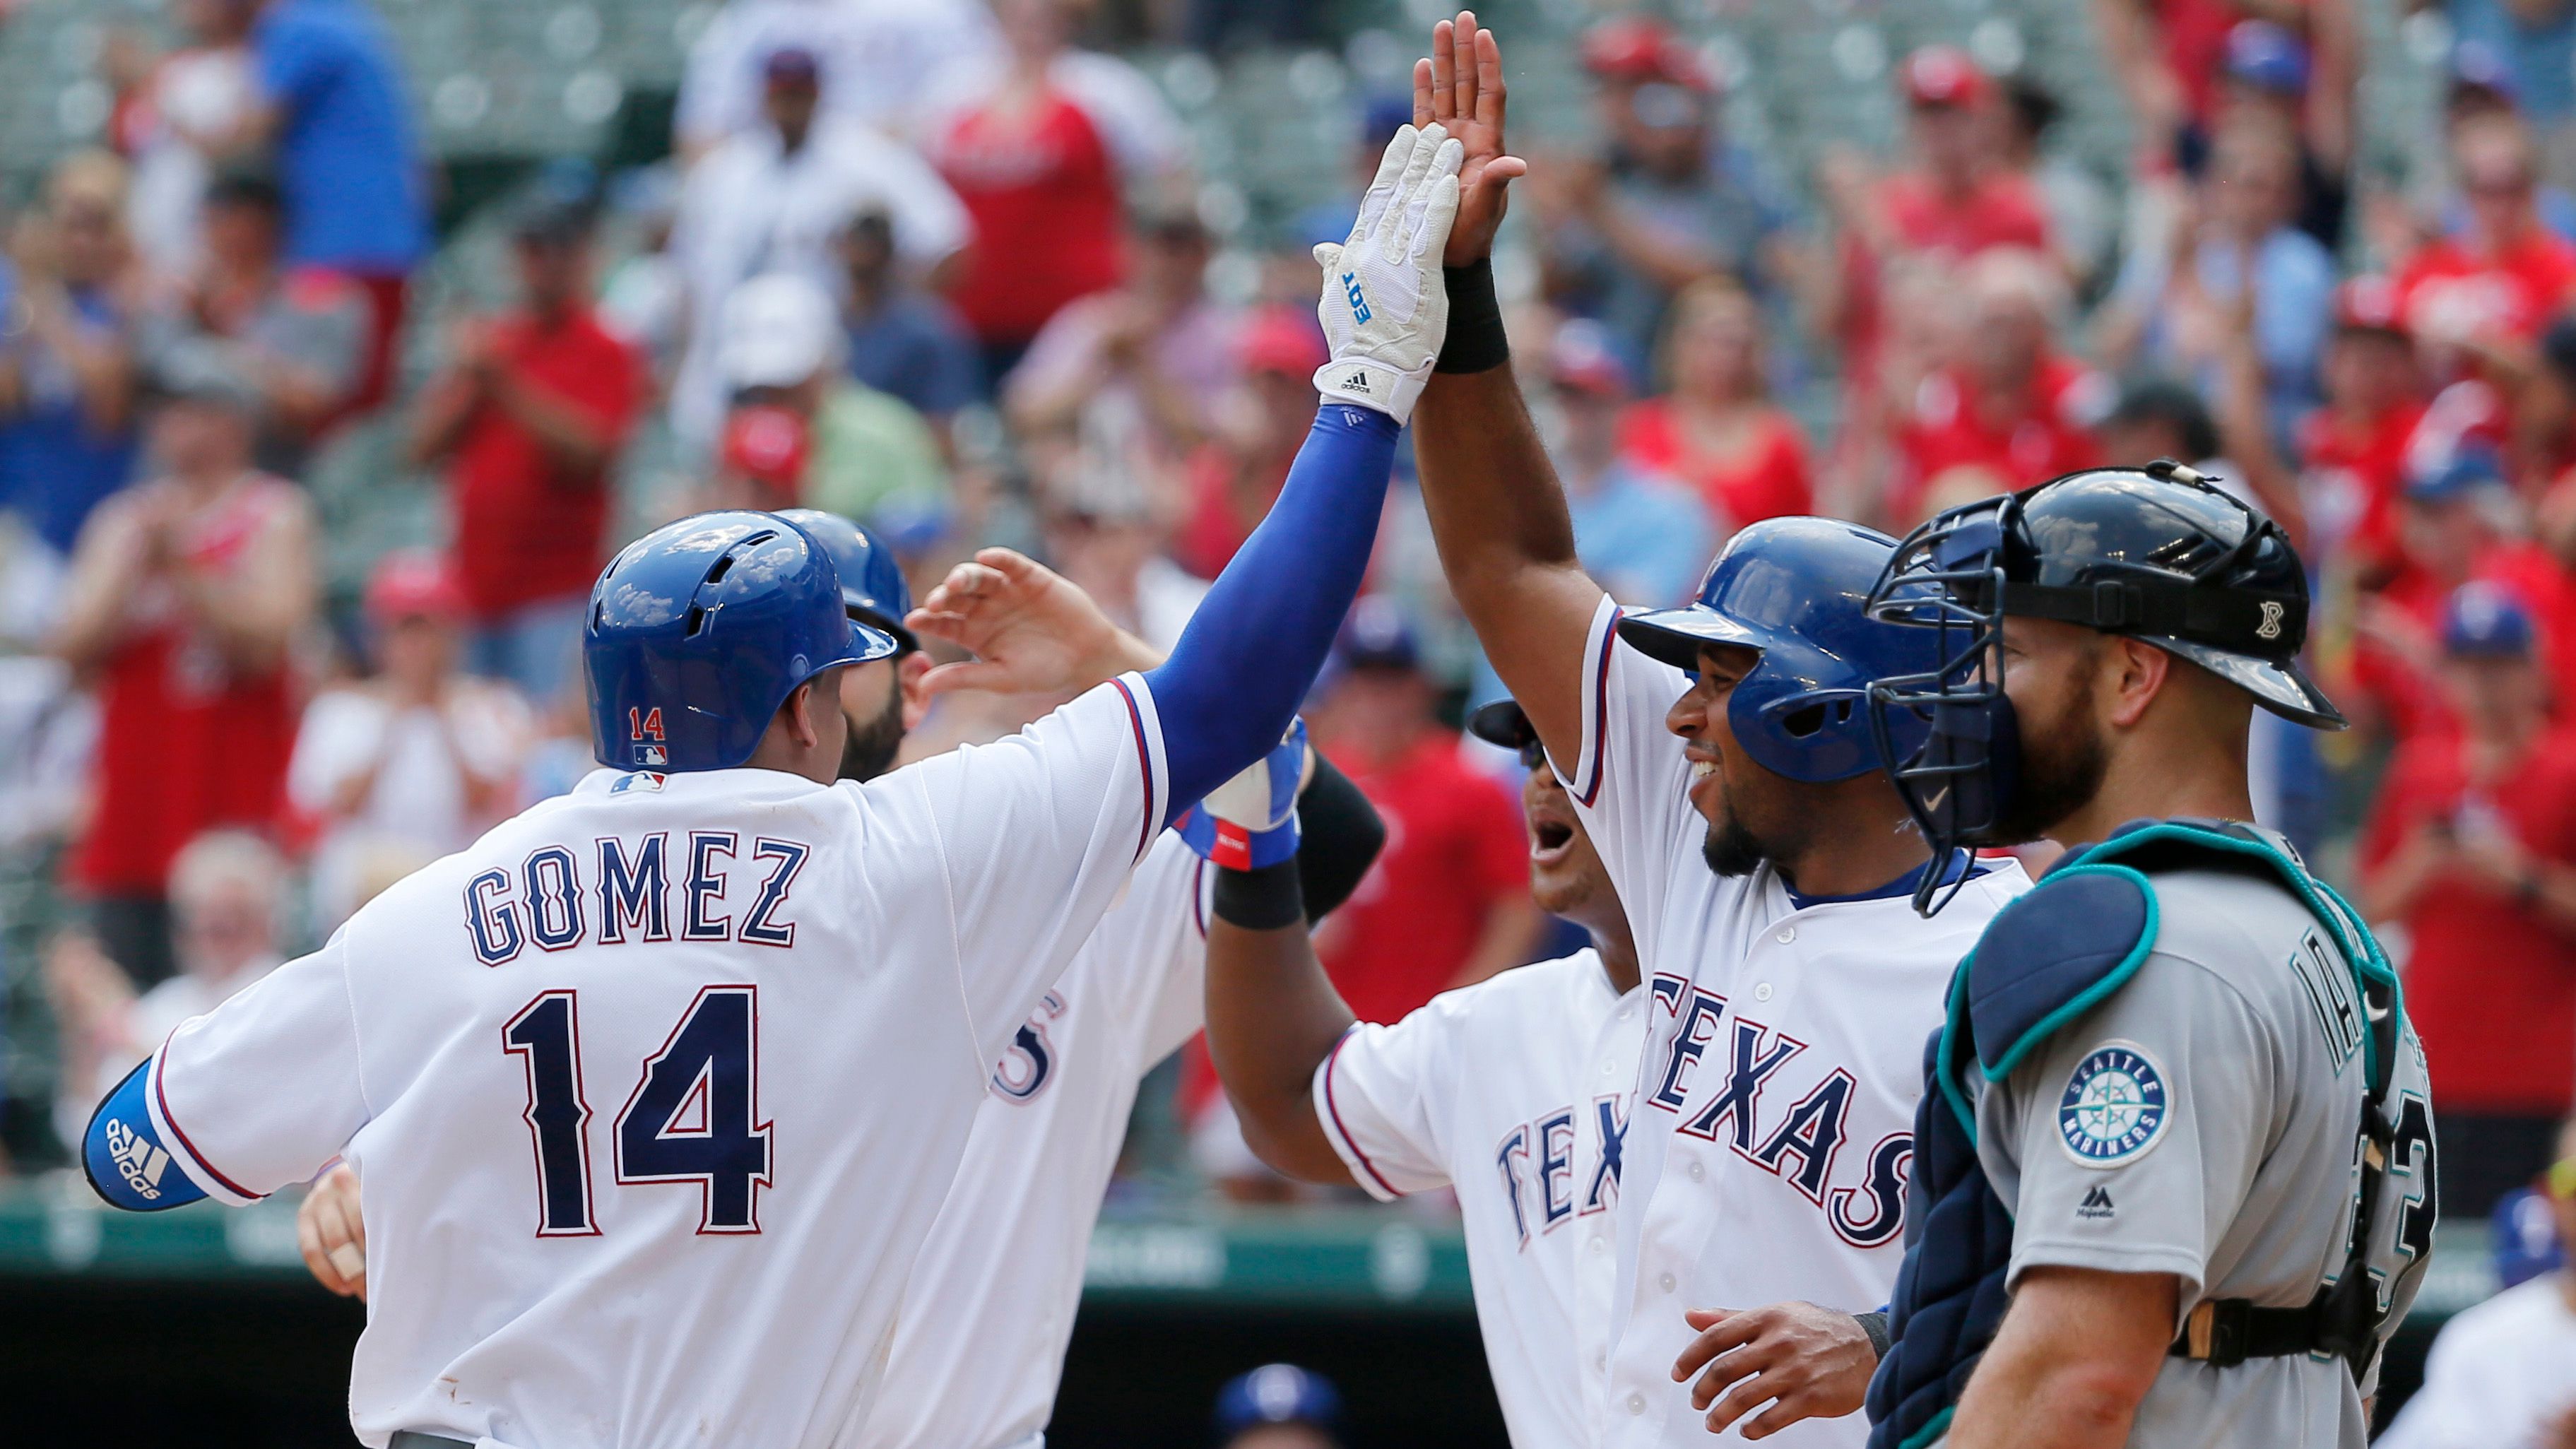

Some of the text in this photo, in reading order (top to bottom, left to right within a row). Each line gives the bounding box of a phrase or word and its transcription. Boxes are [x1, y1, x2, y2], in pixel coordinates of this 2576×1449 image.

[630, 706, 666, 740] 14
[464, 832, 810, 967] GOMEZ
[502, 985, 774, 1238] 14
[2070, 1051, 2159, 1094] SEATTLE
[105, 1118, 162, 1200] adidas
[1494, 1092, 1633, 1254] TEX
[2063, 1114, 2157, 1157] MARINERS
